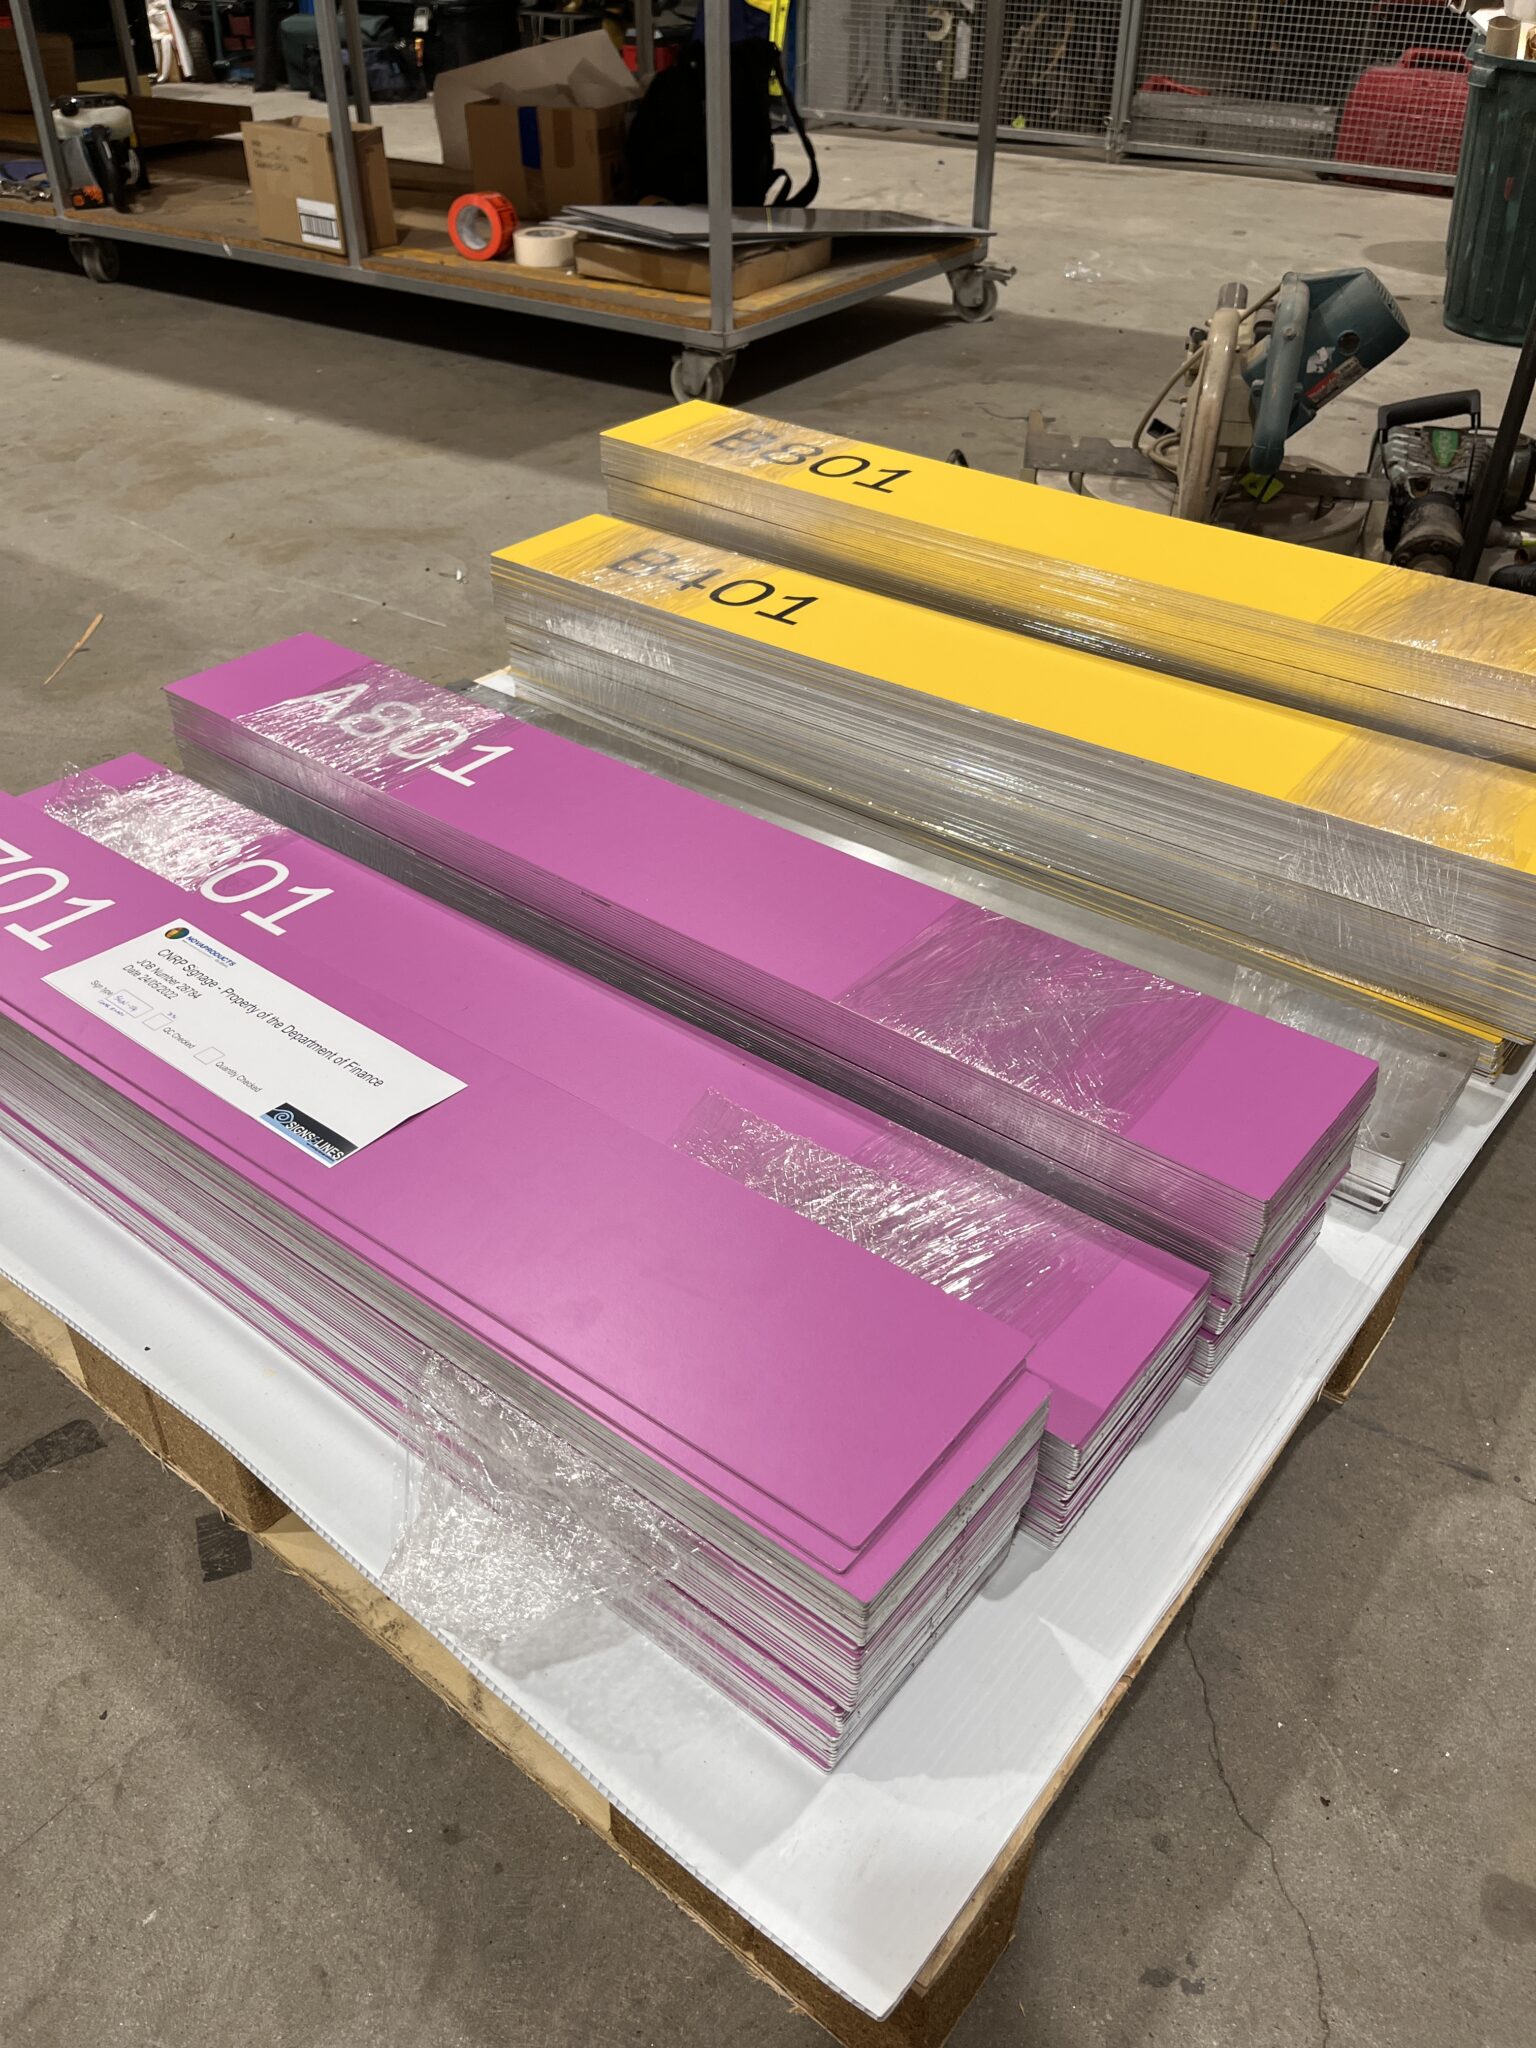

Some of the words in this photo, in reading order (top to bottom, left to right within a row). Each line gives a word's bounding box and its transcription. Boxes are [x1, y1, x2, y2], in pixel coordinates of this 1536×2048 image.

[607, 548, 819, 626] B401
[284, 682, 514, 788] A801
[186, 935, 237, 967] NOVAPRODUCTS
[122, 964, 141, 977] Date
[138, 974, 179, 1000] 24/05/2022
[137, 959, 156, 970] JOB
[152, 967, 180, 985] Number
[176, 983, 203, 999] 28784
[157, 948, 189, 966] CNRP
[182, 963, 219, 989] Signage
[220, 987, 261, 1014] Property
[256, 1010, 273, 1021] of
[266, 1015, 285, 1029] the
[281, 1024, 337, 1060] Department
[333, 1055, 351, 1068] of
[343, 1061, 385, 1087] Finance
[163, 1026, 175, 1035] QC
[171, 1032, 196, 1049] Checked
[215, 1061, 238, 1078] Quantity
[236, 1074, 263, 1093] Checked
